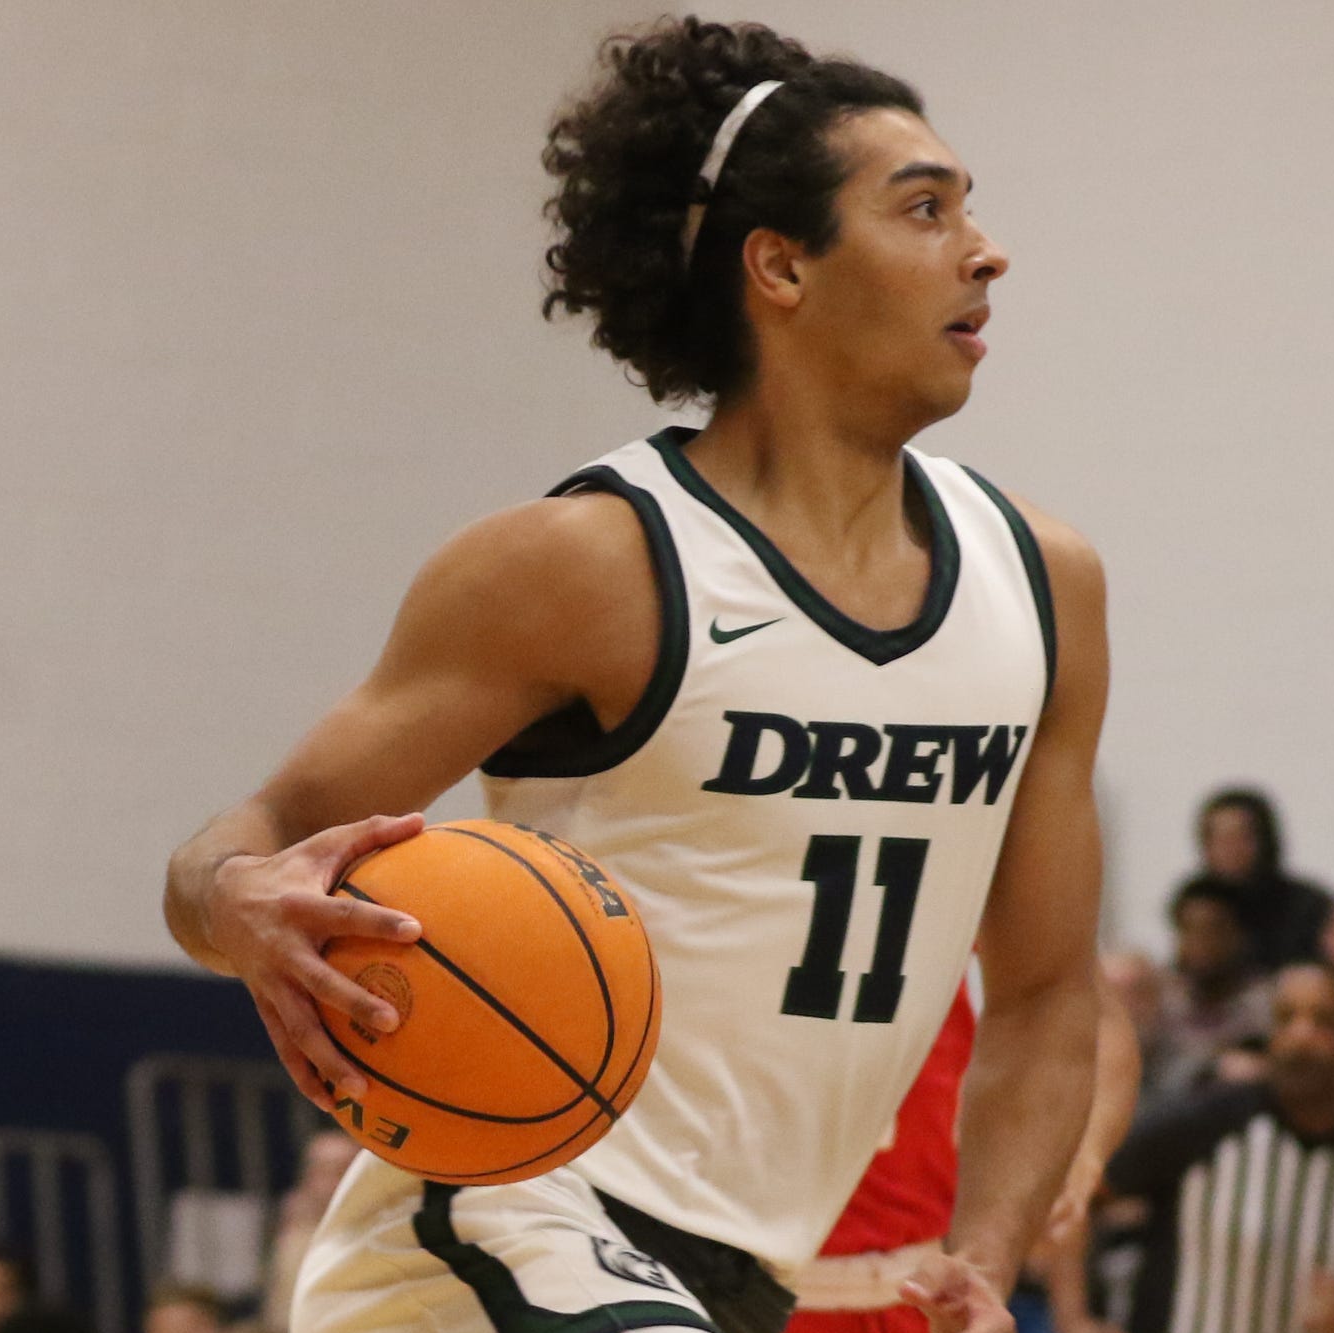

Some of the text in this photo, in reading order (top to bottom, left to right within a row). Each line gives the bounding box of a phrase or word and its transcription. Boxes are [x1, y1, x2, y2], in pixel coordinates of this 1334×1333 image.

[700, 710, 1029, 805] DREW
[779, 834, 932, 1024] 11
[322, 1080, 412, 1151] EV
